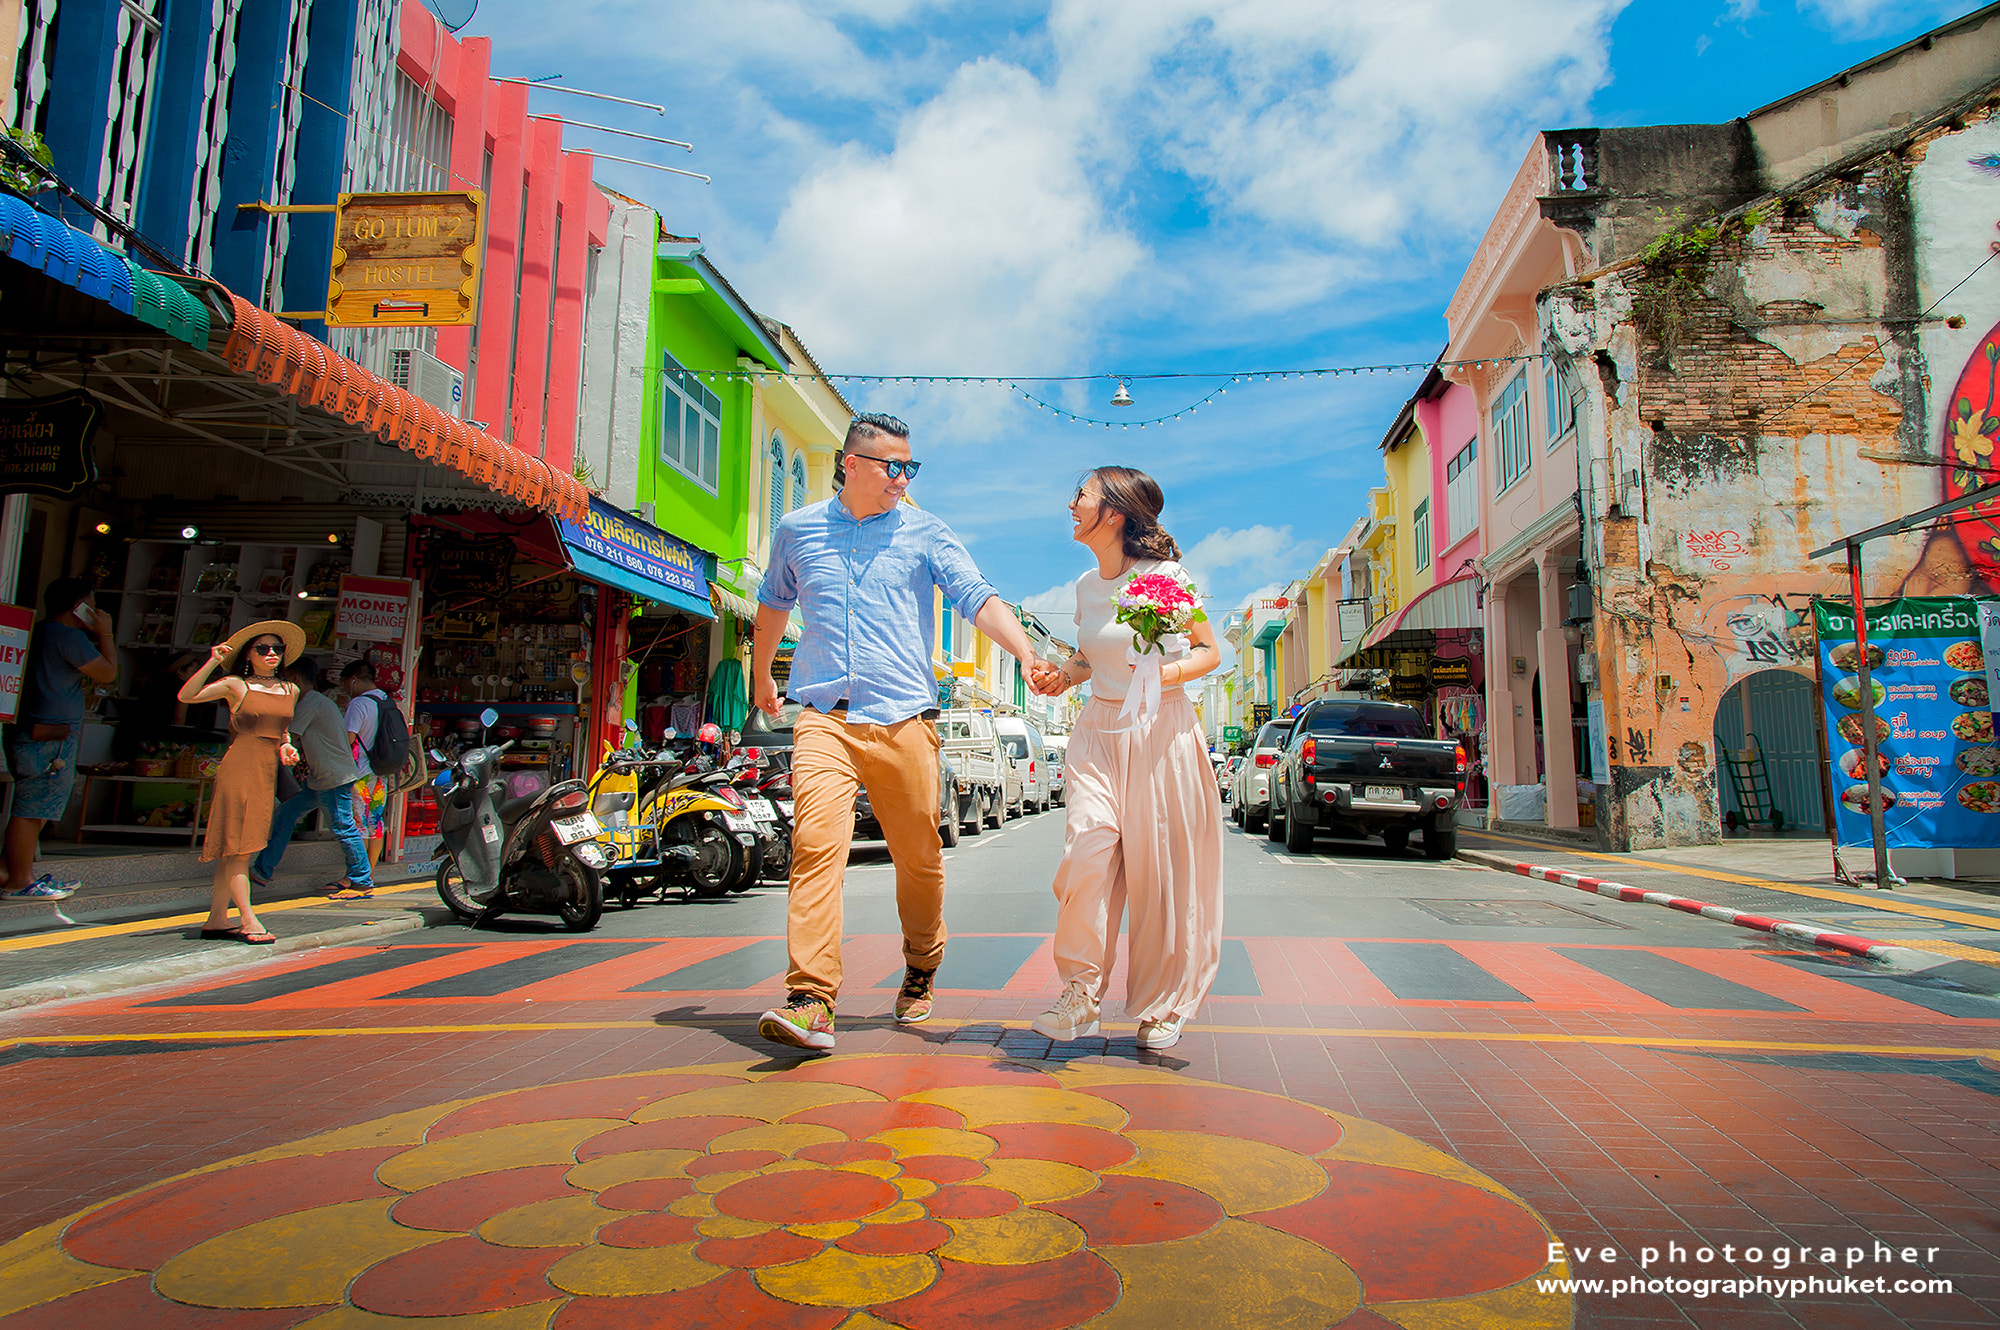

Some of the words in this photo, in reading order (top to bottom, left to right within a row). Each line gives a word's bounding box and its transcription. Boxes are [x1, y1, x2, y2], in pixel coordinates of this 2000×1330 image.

[354, 217, 385, 240] GO
[393, 215, 438, 238] TUM
[448, 214, 462, 237] 2
[364, 264, 440, 284] HOSTEL
[13, 442, 61, 460] Shiang
[441, 549, 484, 561] GOTUM
[585, 535, 604, 557] 076
[605, 545, 624, 563] 211
[625, 554, 647, 574] 680,
[647, 563, 664, 579] 076
[1709, 559, 1730, 571] 16
[341, 597, 407, 614] MONEY
[339, 611, 405, 628] EXCHANGE
[1889, 692, 1914, 702] green
[1916, 692, 1938, 701] curry
[1892, 728, 1916, 739] Suki
[1919, 730, 1947, 741] soup
[1896, 764, 1933, 778] Carry
[1897, 798, 1918, 807] fried
